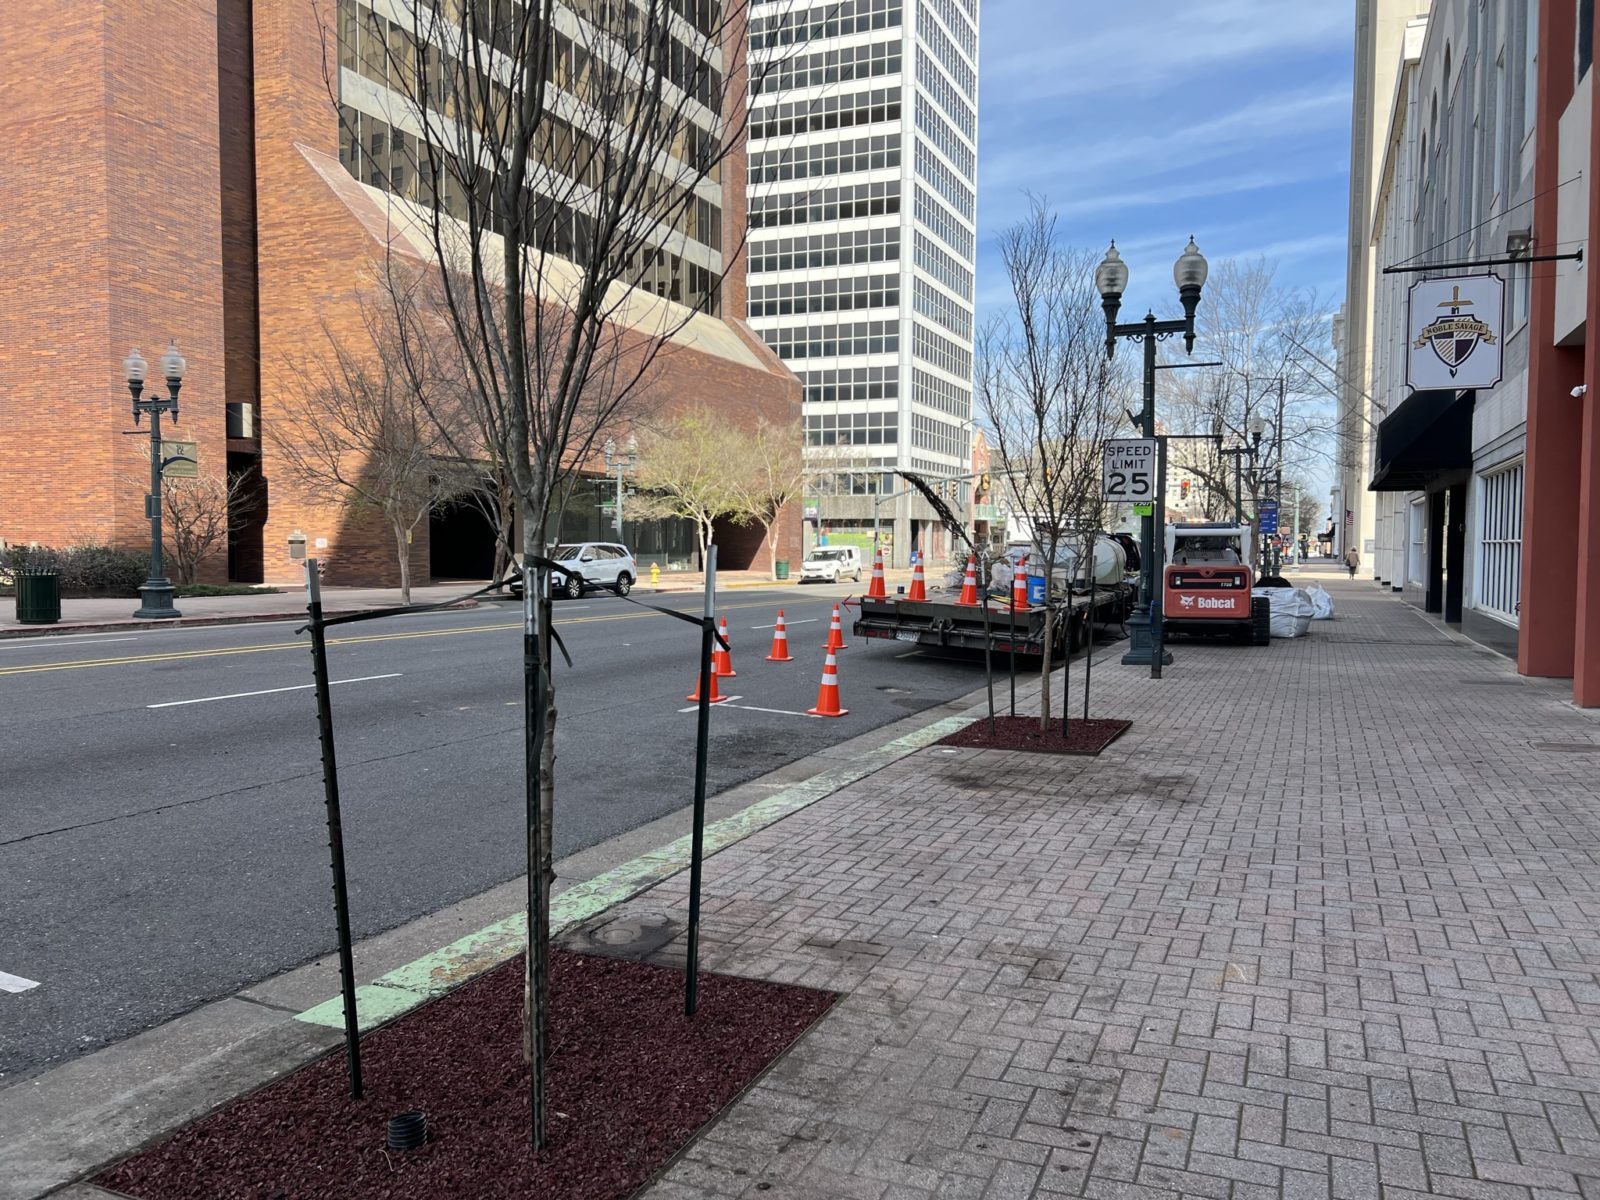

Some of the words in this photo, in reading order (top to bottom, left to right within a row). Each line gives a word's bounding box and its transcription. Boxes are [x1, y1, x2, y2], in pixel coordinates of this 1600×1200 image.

[1426, 323, 1454, 335] NOBLE
[1454, 322, 1485, 331] SAVAGE
[1107, 446, 1151, 456] SPEED
[1112, 459, 1146, 469] LIMIT
[1107, 472, 1150, 496] 25
[1197, 597, 1235, 609] Bobcat
